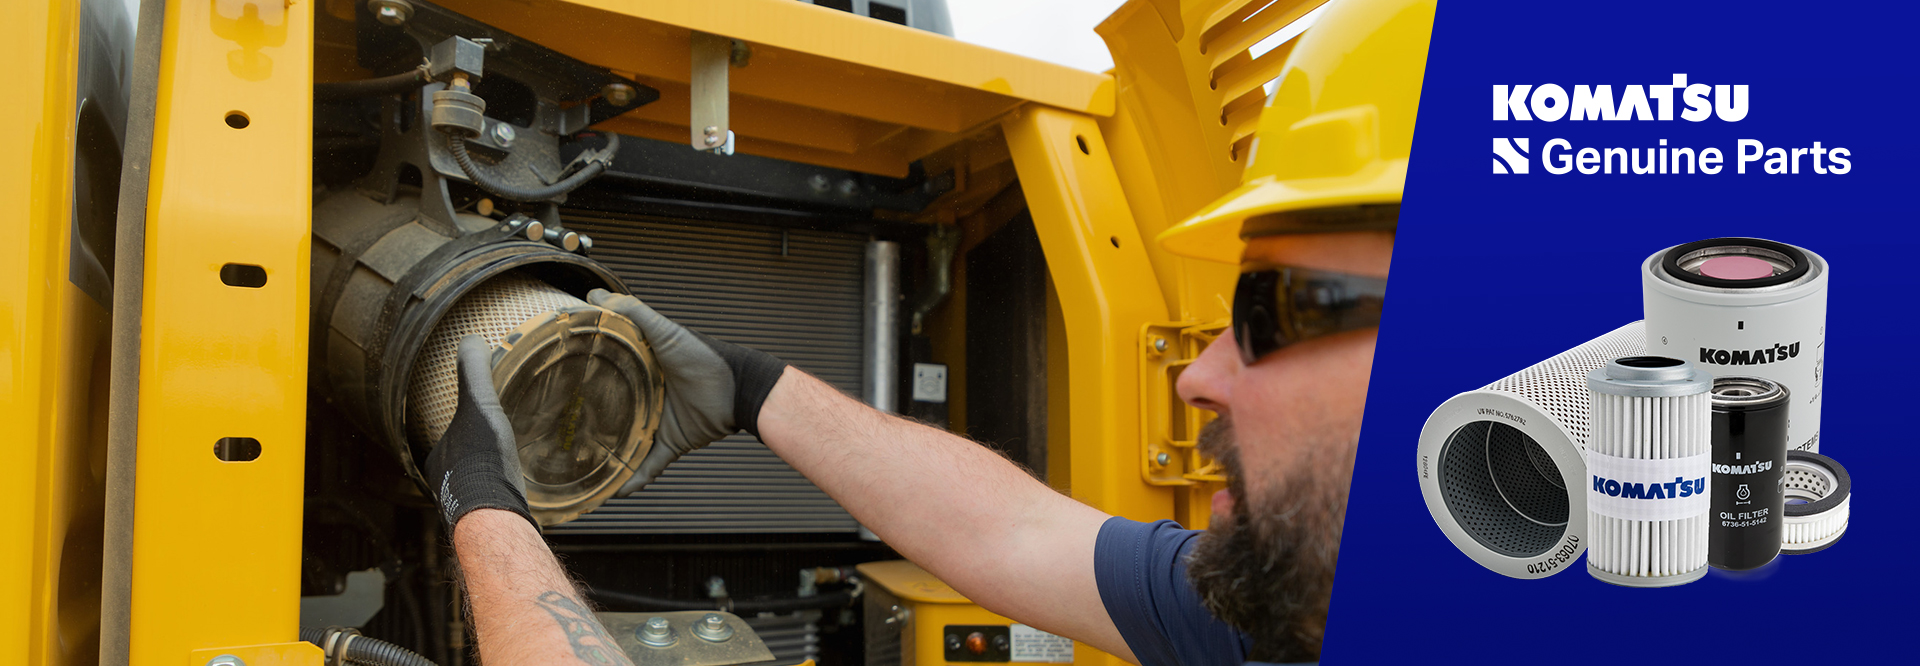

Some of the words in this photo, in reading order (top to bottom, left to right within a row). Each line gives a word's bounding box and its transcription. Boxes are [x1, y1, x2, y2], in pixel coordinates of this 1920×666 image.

[1700, 341, 1800, 365] KOMATSU
[1712, 461, 1772, 475] KOMATSU
[1593, 475, 1705, 499] KOMATSU
[1720, 512, 1736, 520] OIL
[1738, 508, 1769, 520] FILTER
[1527, 534, 1580, 574] 07063-51210
